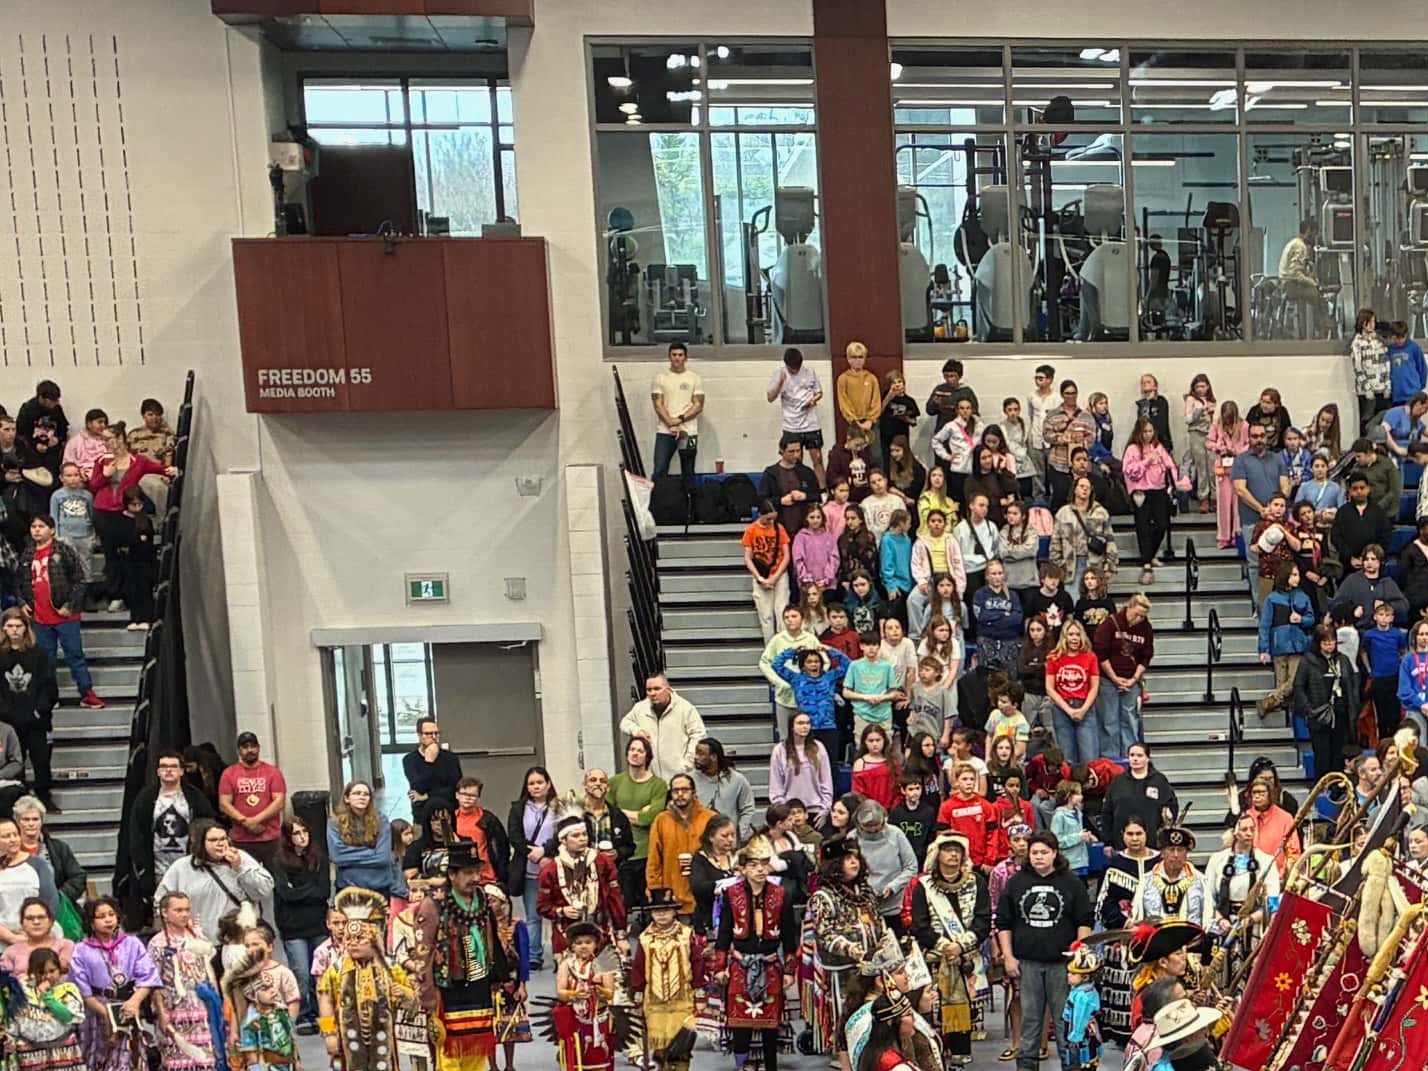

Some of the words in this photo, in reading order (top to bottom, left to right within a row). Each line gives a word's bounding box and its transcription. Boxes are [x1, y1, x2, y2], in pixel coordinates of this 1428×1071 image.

[258, 369, 346, 385] FREEDOM
[350, 367, 372, 384] 55
[260, 387, 296, 398] MEDIA
[297, 386, 336, 398] BOOTH
